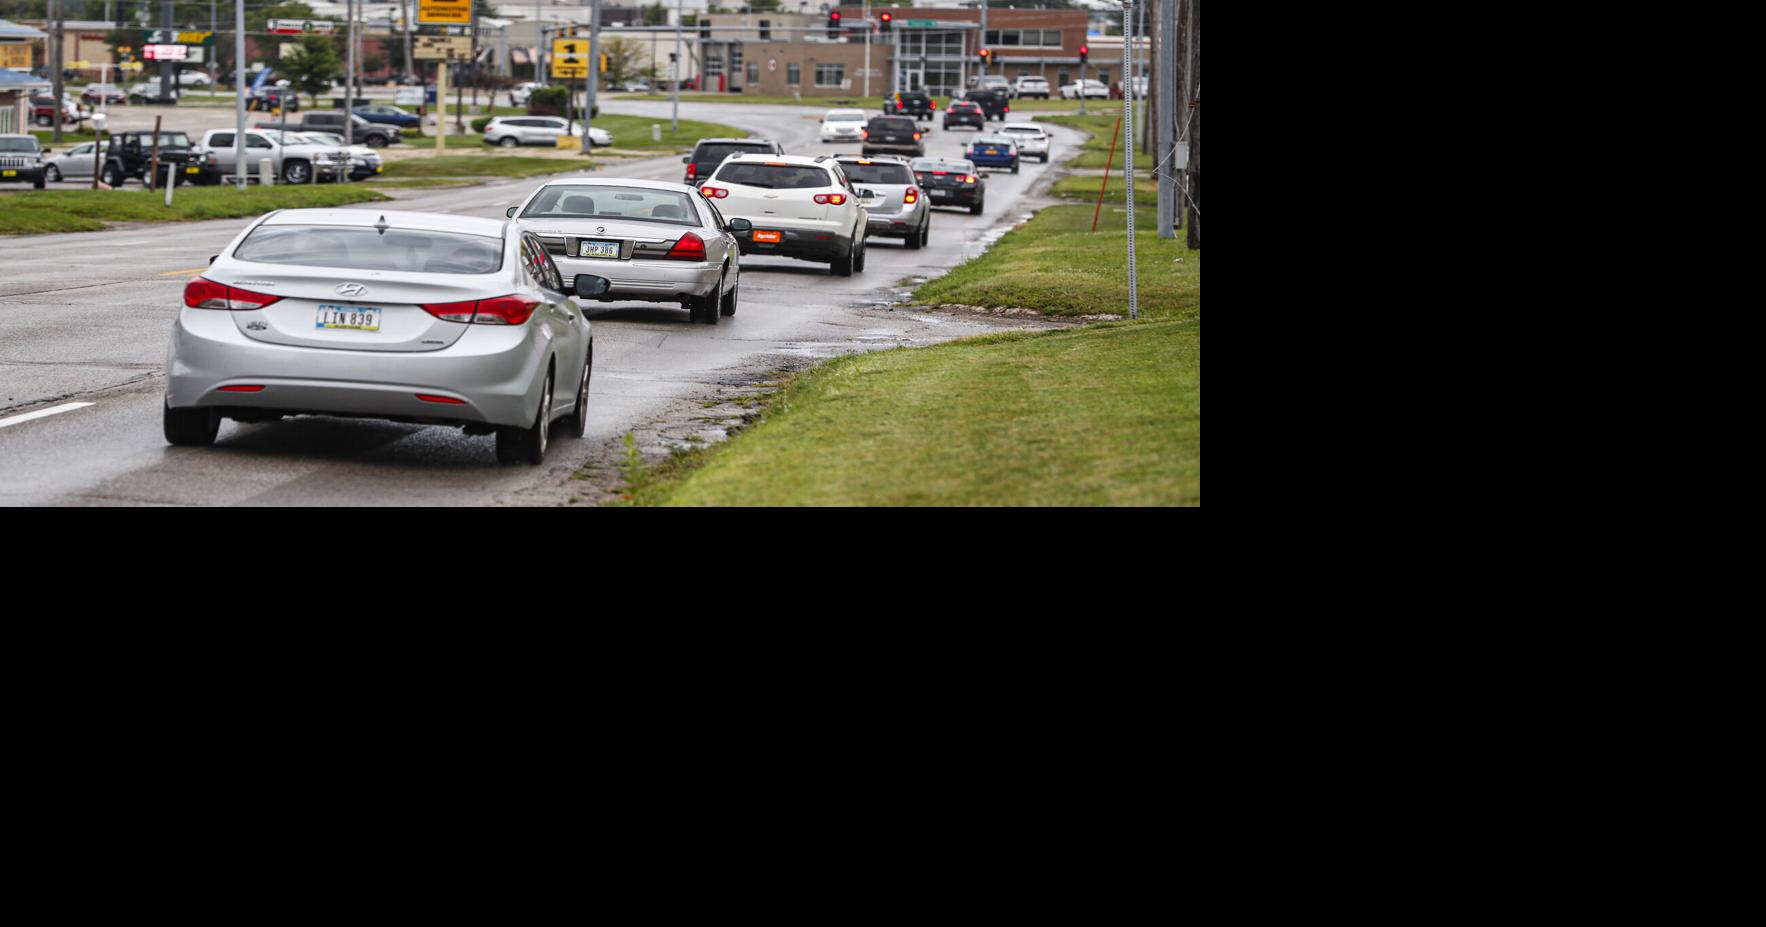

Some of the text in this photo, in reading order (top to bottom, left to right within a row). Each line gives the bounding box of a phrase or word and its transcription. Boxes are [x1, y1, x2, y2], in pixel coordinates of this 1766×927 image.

[586, 246, 599, 254] JHP
[323, 311, 373, 326] LIN 839
